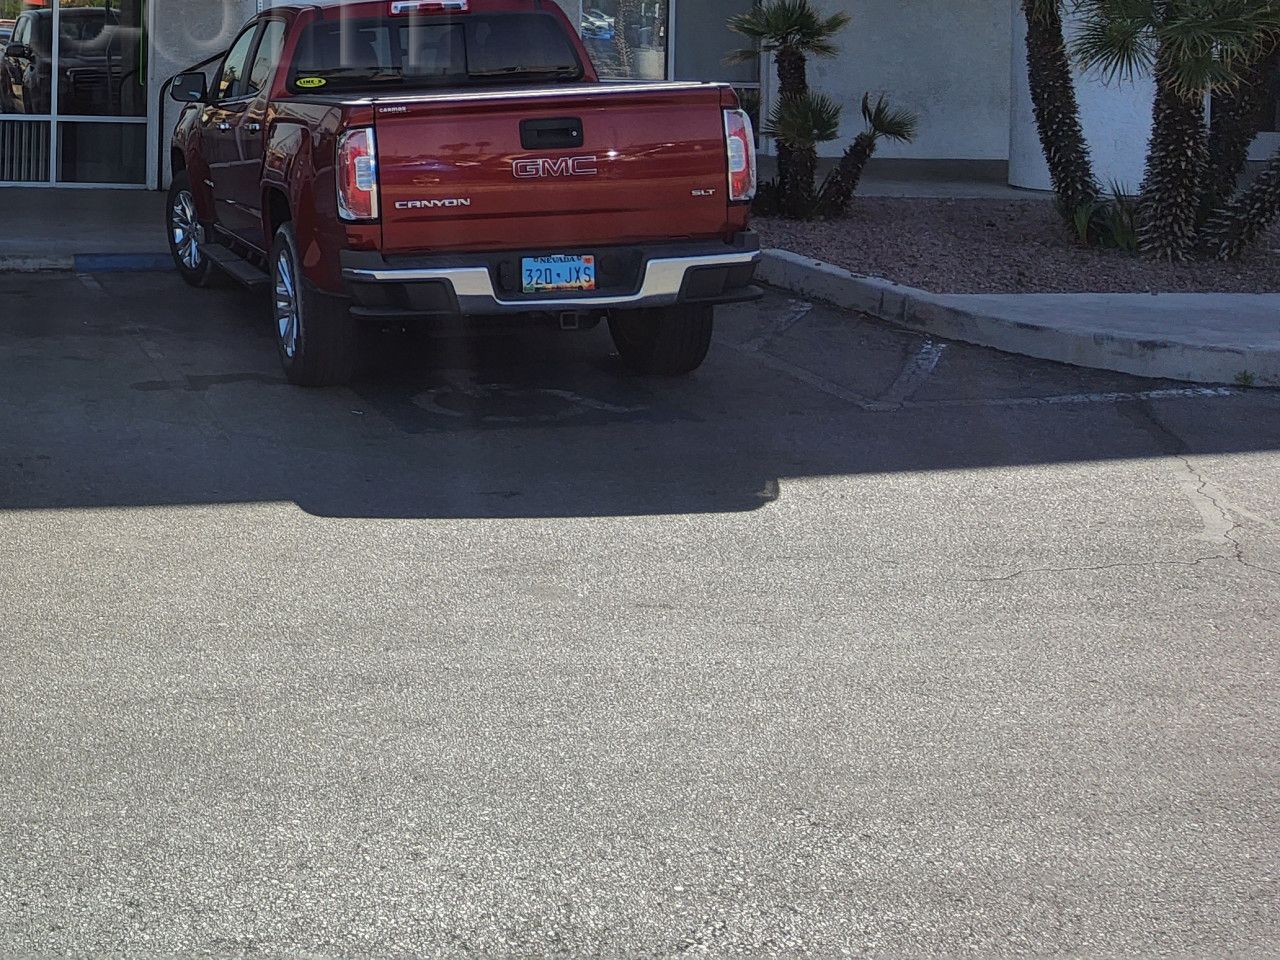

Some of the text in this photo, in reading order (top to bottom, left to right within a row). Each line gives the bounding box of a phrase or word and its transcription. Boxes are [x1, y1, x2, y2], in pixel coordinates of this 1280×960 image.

[512, 155, 597, 178] GMC
[691, 188, 715, 196] SLT
[395, 197, 471, 209] CANYON
[540, 256, 576, 264] NEVADA
[525, 267, 591, 285] 320 JXS
